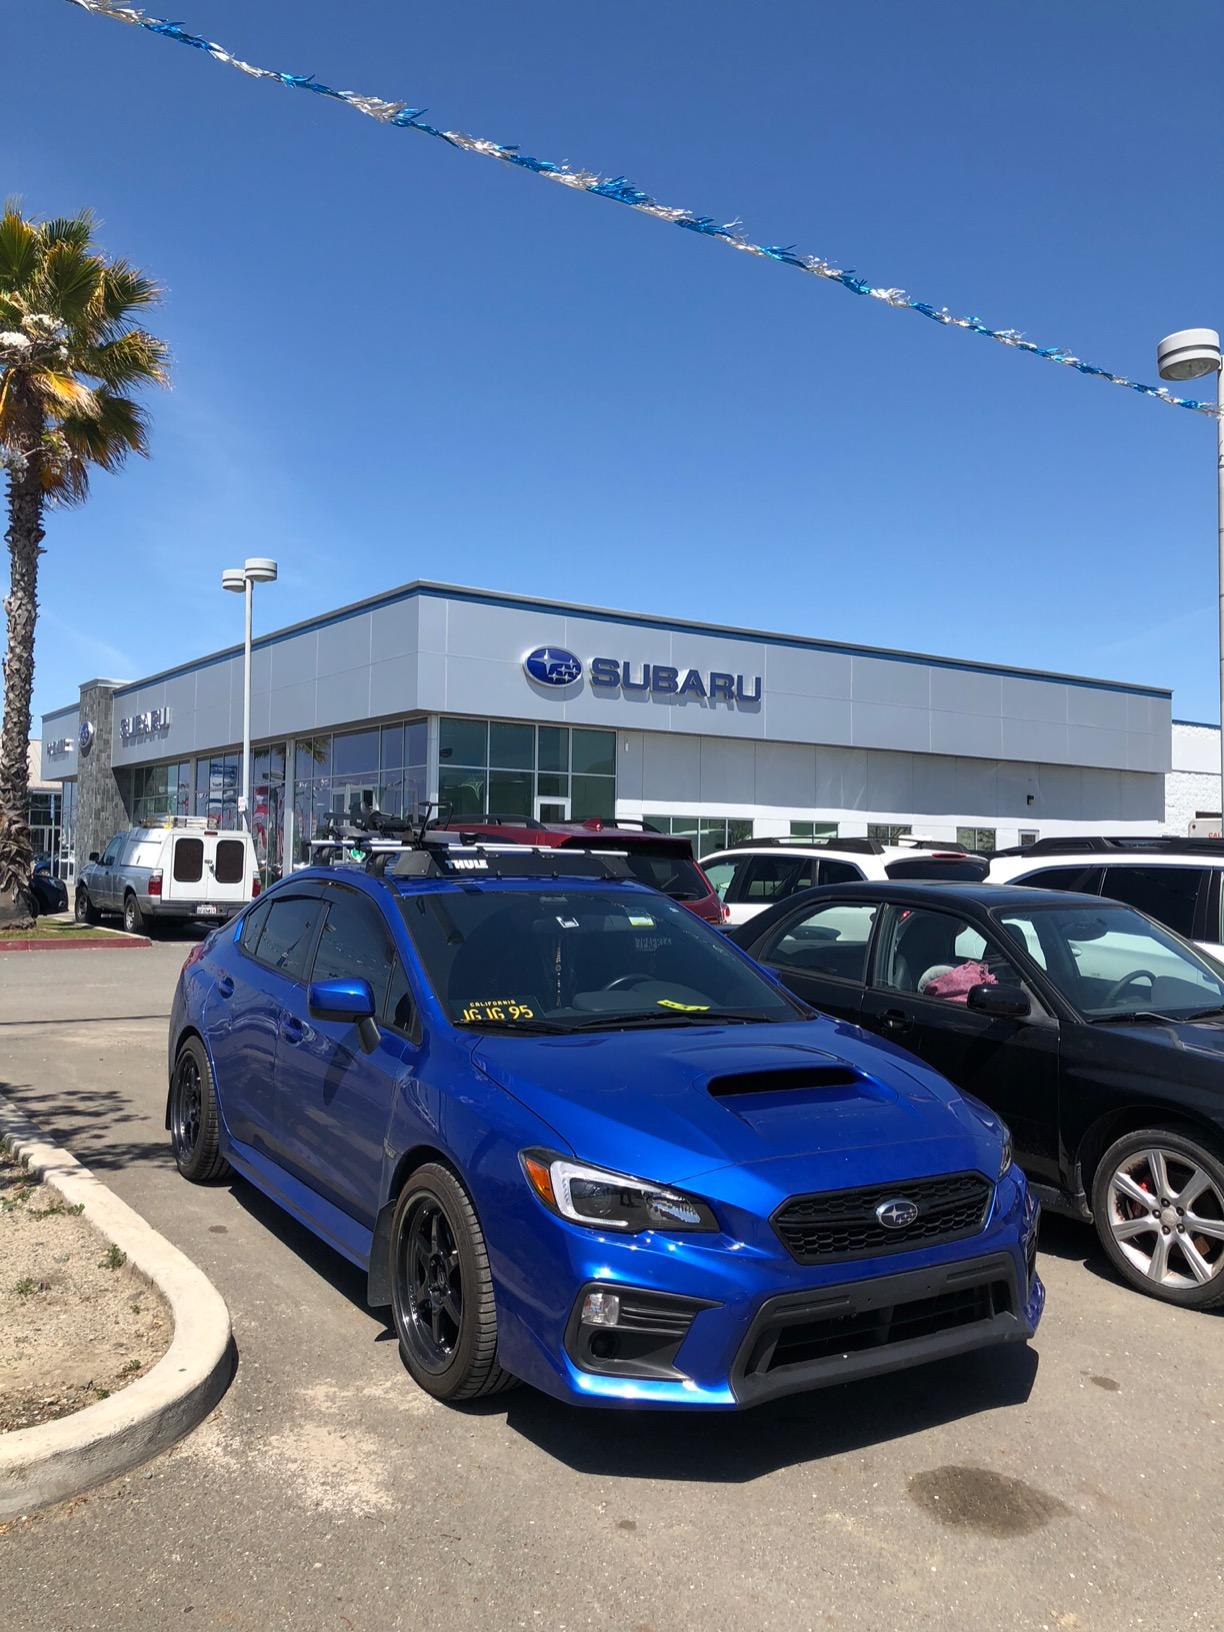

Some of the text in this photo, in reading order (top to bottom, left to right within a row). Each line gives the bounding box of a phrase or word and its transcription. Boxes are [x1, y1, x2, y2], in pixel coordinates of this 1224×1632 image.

[590, 657, 762, 702] SUBARU
[445, 859, 489, 869] THULE
[469, 999, 516, 1008] CALIFORNIA
[508, 1004, 534, 1020] 95
